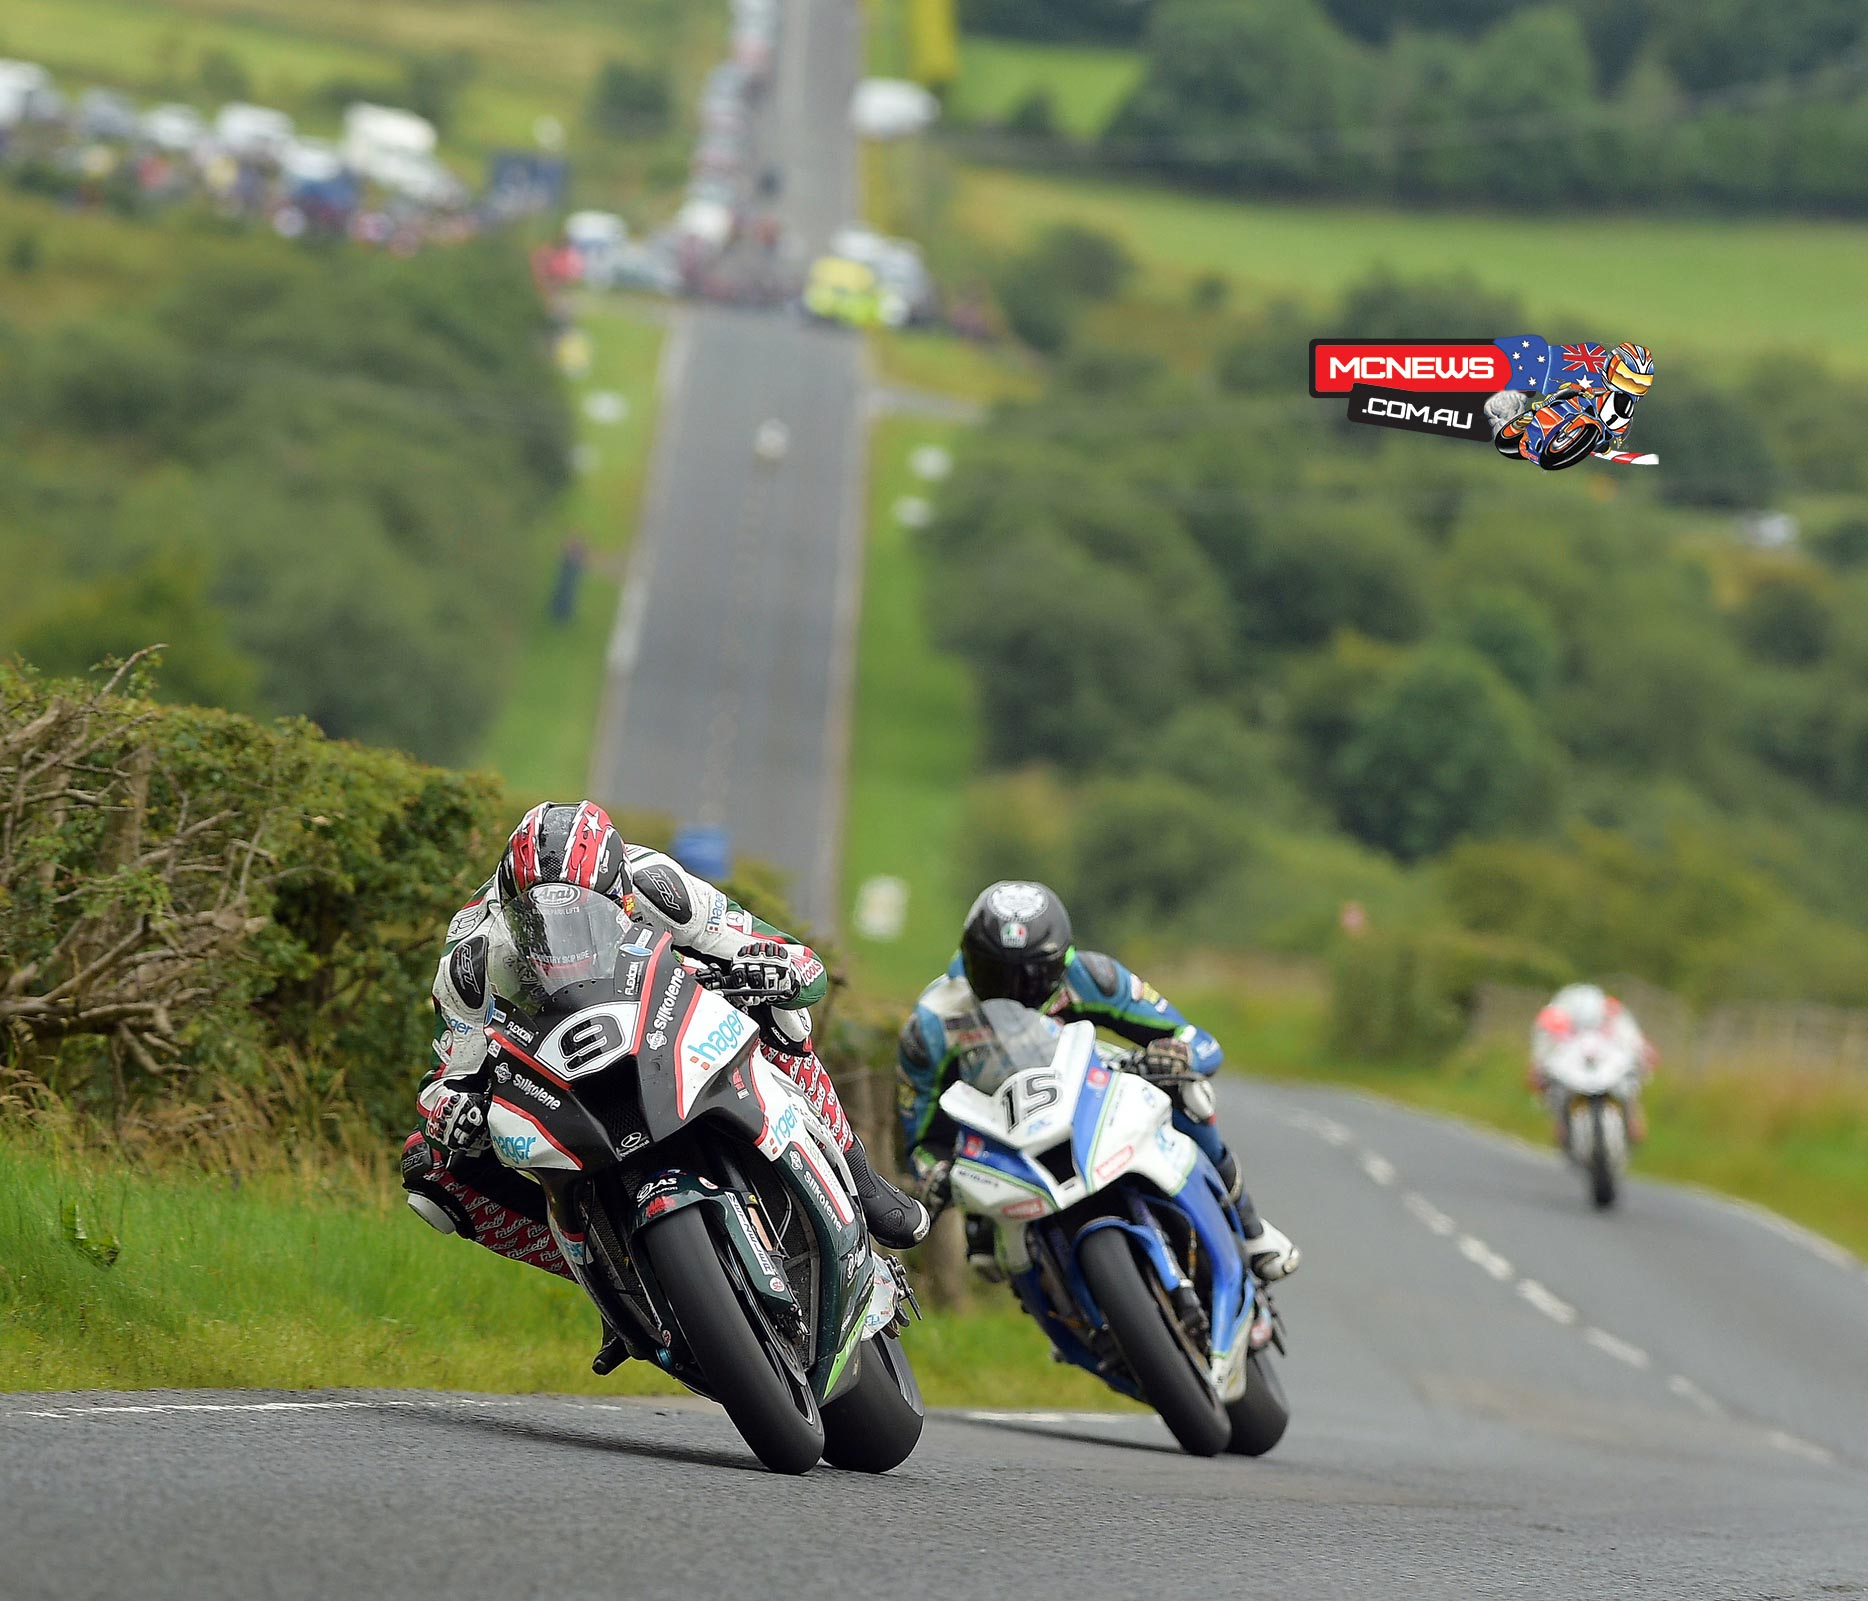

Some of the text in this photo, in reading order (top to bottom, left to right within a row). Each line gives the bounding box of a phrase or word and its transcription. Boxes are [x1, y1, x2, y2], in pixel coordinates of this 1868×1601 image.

[540, 887, 572, 900] Arai
[558, 1014, 625, 1072] 9
[1002, 1069, 1063, 1135] 15
